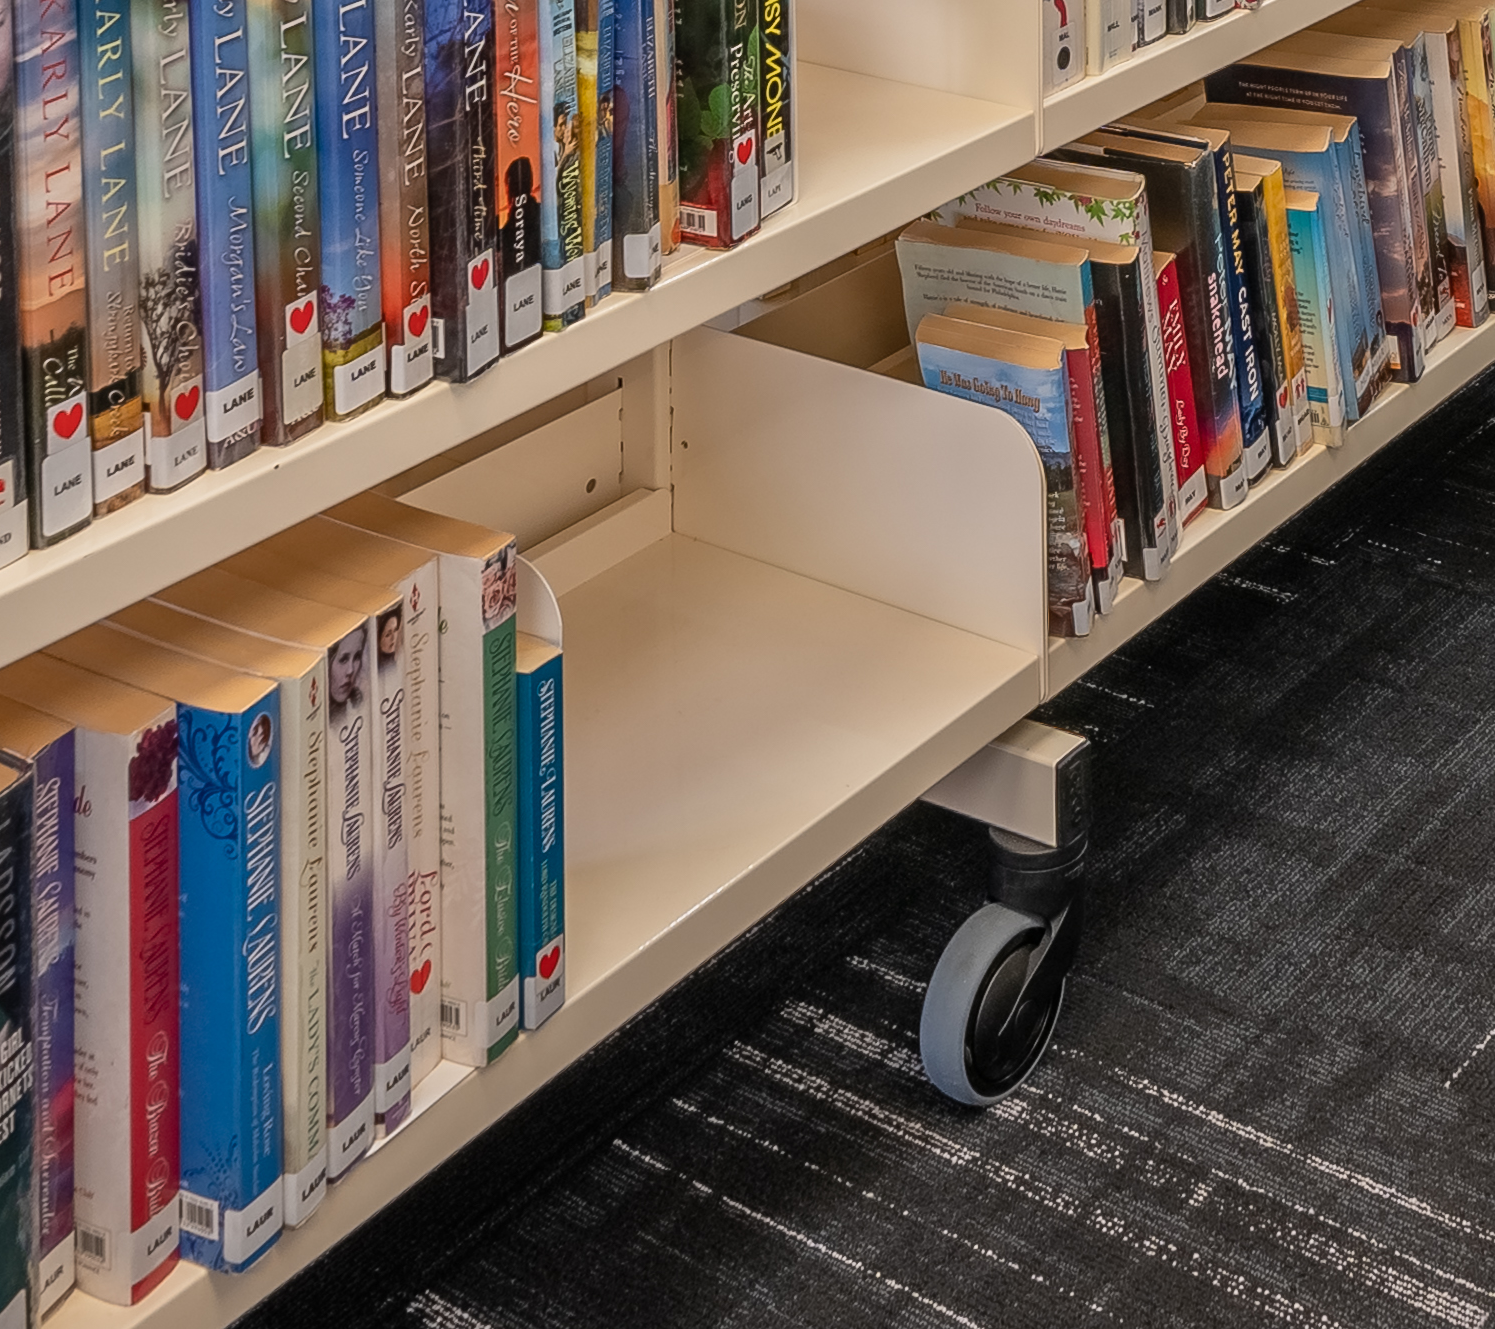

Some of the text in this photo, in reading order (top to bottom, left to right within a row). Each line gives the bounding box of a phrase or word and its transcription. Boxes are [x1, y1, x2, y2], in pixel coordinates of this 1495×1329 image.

[98, 140, 131, 272] LANE
[1222, 152, 1258, 401] PETER MAY CAST IRON
[1, 1027, 24, 1065] GIRL
